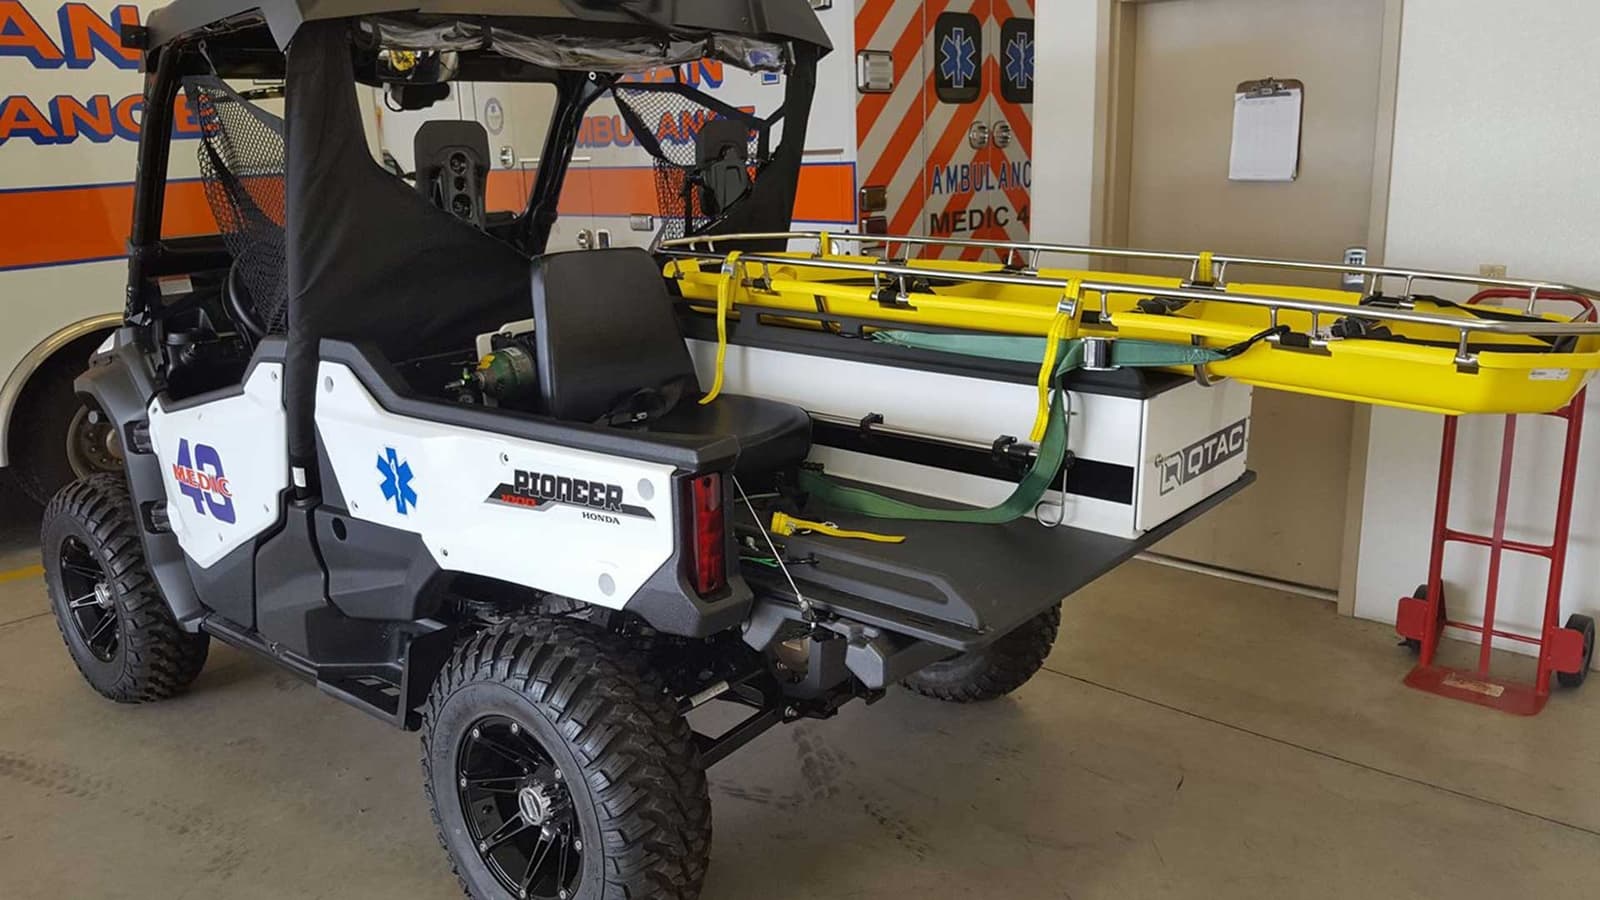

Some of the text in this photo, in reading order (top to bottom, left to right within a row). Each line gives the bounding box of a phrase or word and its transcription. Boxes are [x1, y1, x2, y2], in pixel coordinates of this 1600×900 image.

[931, 161, 1032, 195] AMBULANC
[929, 205, 1009, 236] MEDIC
[1187, 424, 1244, 476] QTAC
[172, 463, 233, 499] MEDIC
[513, 468, 624, 513] PIONEER
[581, 511, 621, 526] HONDA
